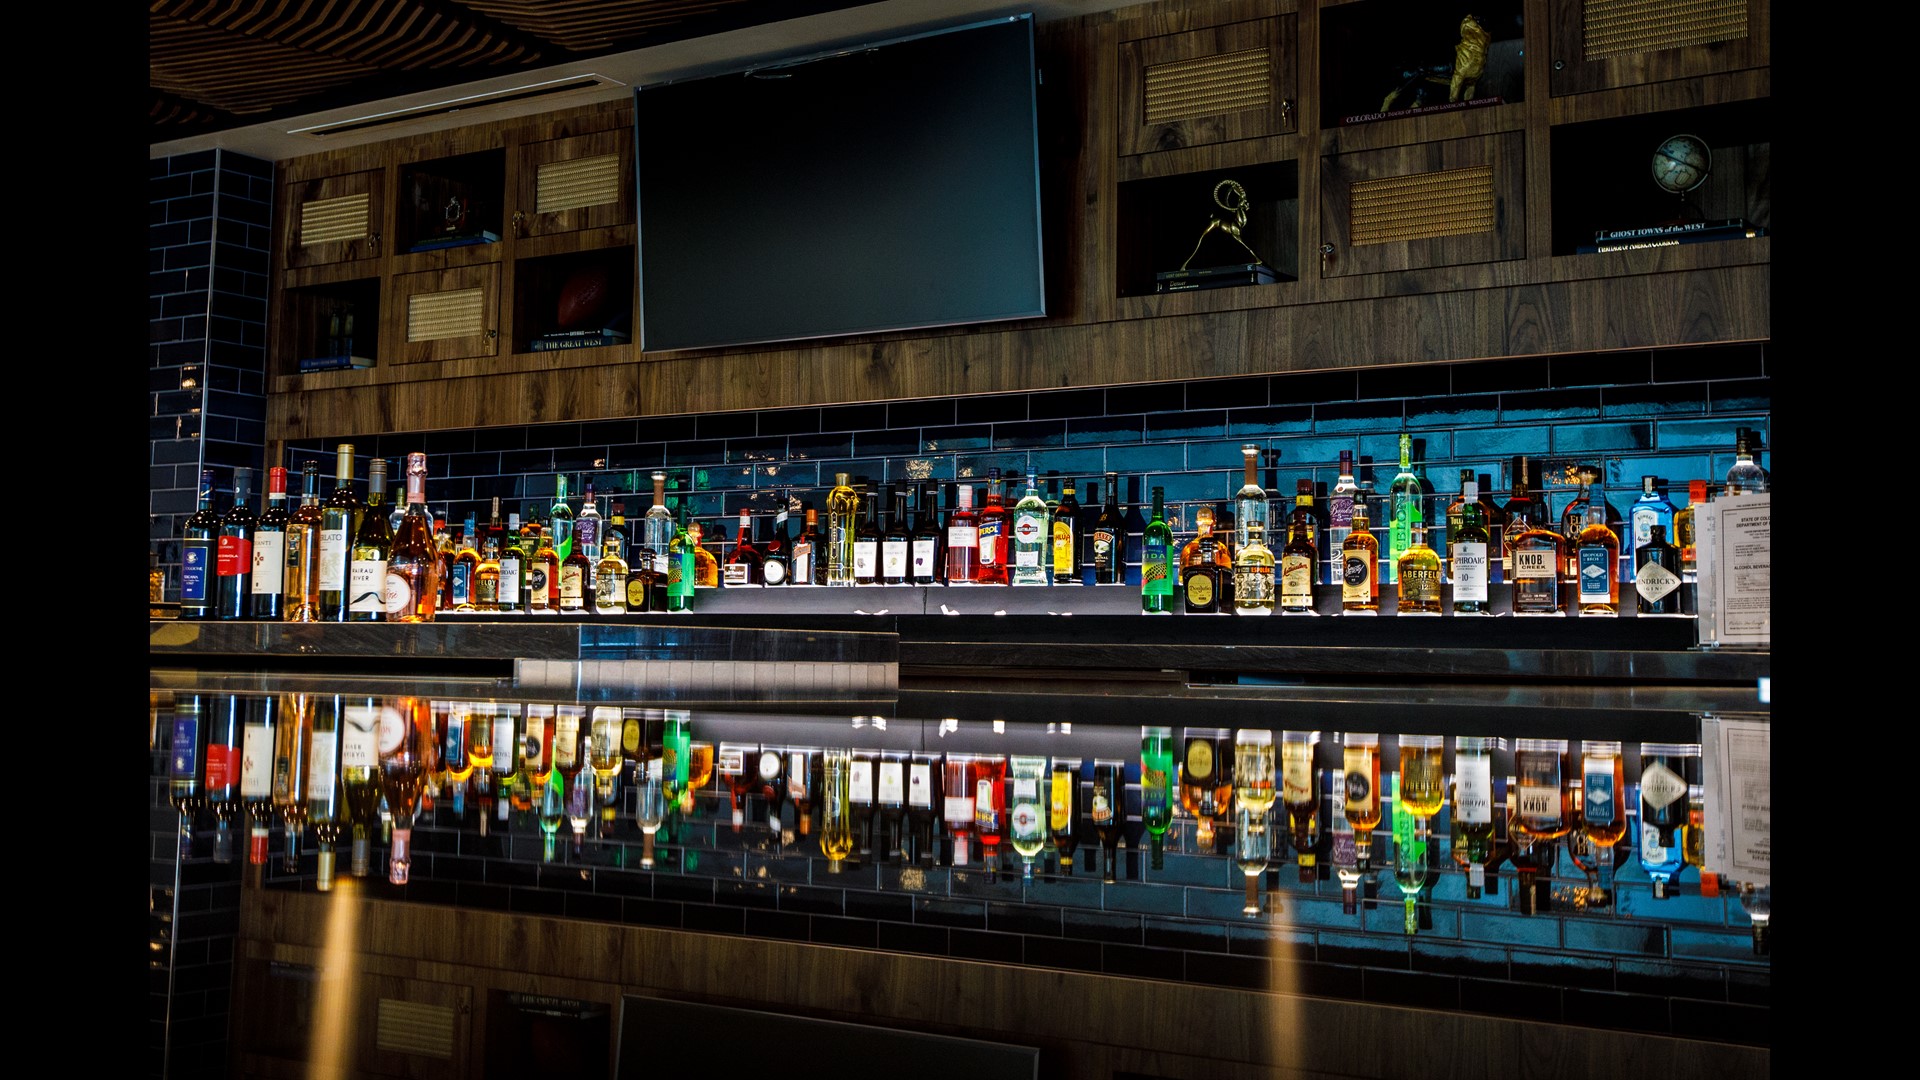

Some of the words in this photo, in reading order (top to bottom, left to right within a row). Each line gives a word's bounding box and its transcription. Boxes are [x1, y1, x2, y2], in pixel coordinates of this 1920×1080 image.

[1346, 112, 1386, 124] COLORADO
[1610, 229, 1636, 238] GHOST
[1636, 226, 1664, 236] TOWNS
[1664, 225, 1673, 233] of
[1673, 224, 1684, 232] the
[1684, 222, 1706, 230] WEST
[545, 342, 560, 350] THE
[560, 340, 582, 348] GREAT
[584, 338, 602, 346] WEST
[1519, 555, 1542, 565] KNOB
